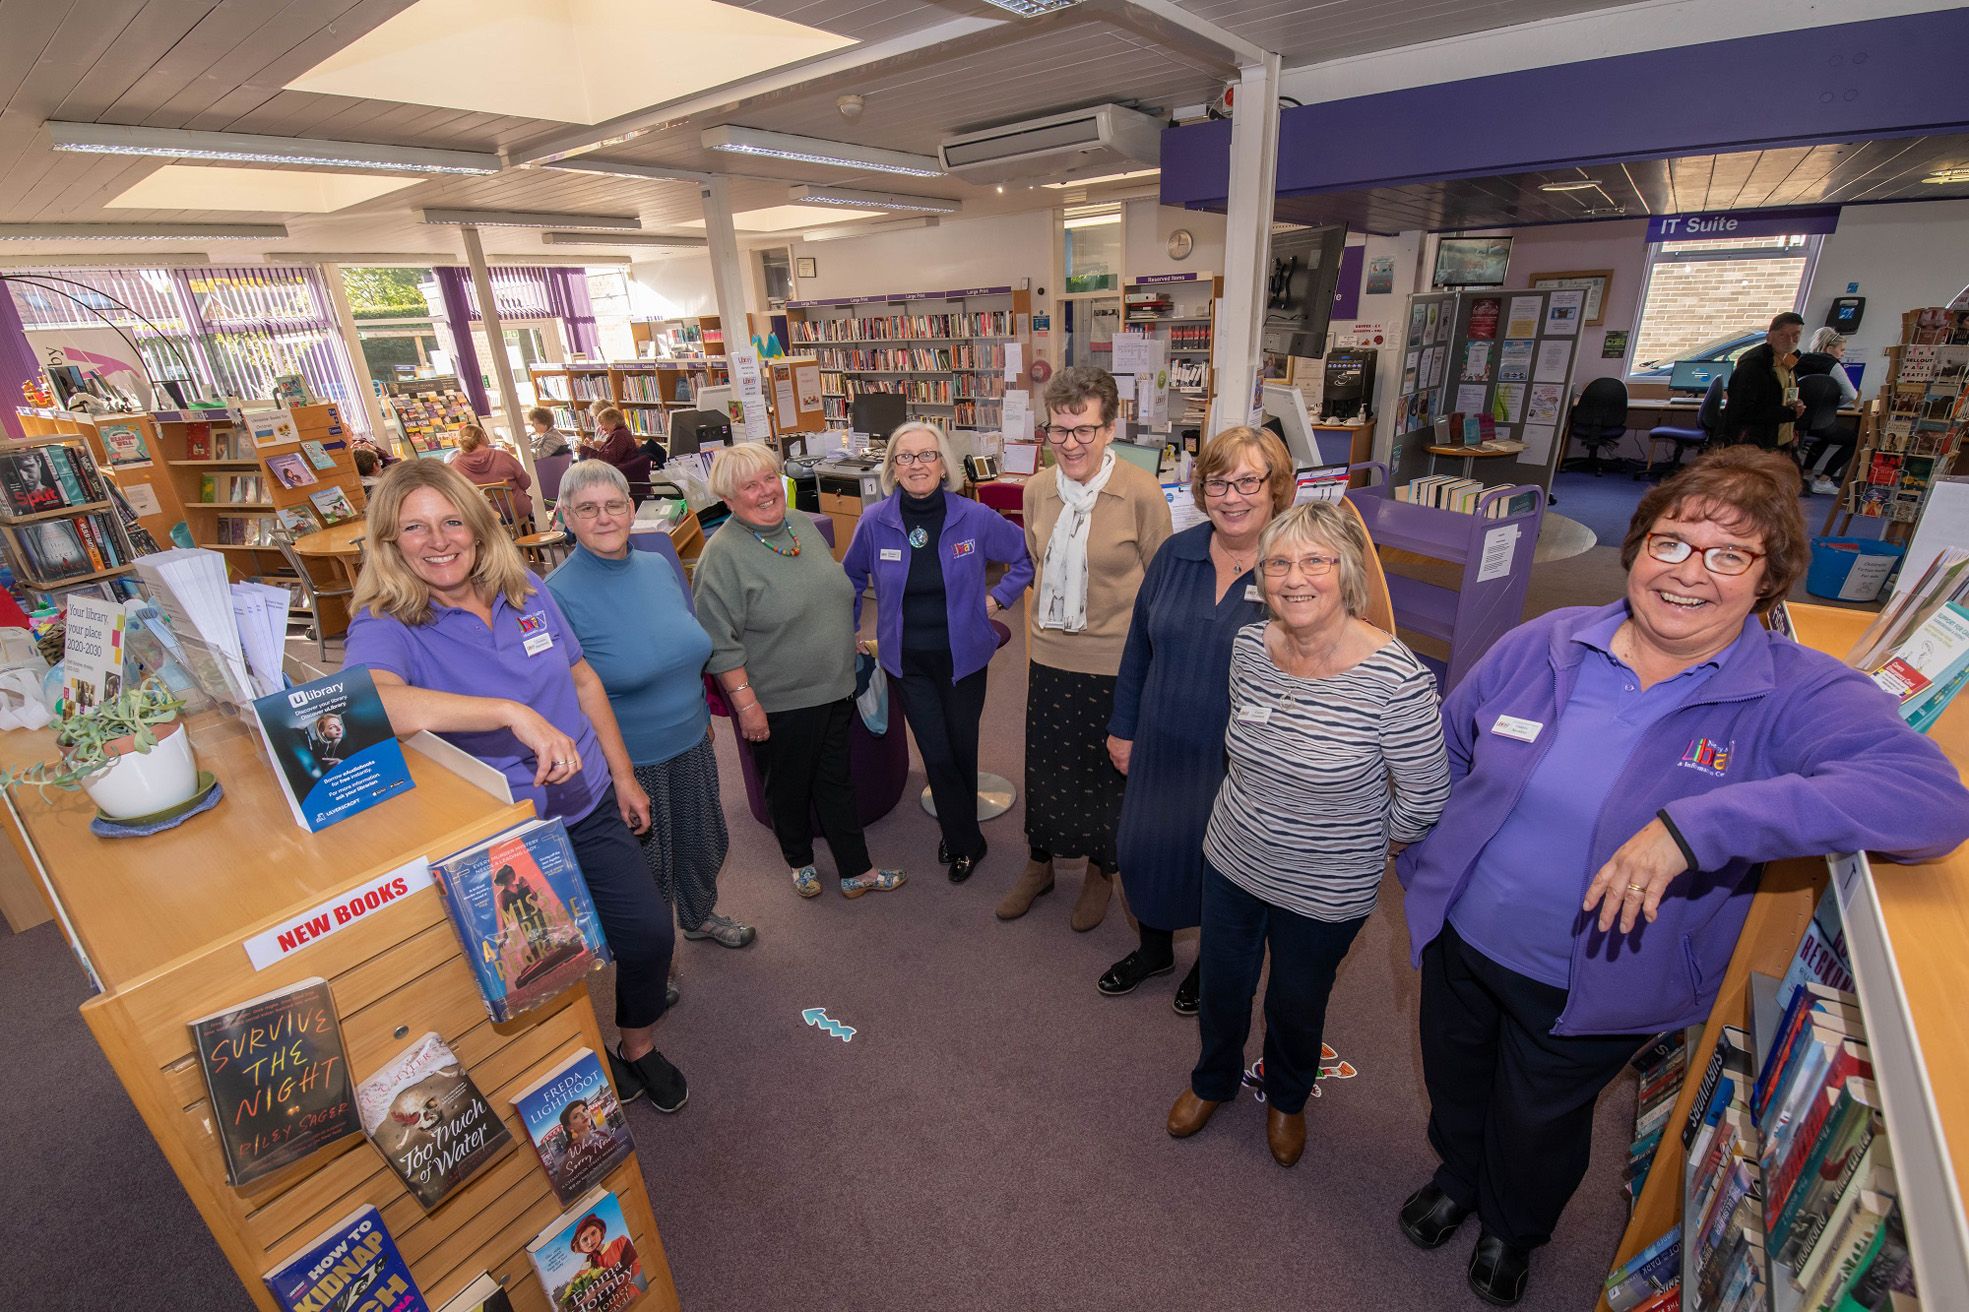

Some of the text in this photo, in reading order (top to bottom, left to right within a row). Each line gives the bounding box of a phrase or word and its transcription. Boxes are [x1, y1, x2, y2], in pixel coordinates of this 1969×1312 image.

[1660, 216, 1738, 235] IT Suite
[869, 484, 874, 492] 1
[69, 604, 84, 616] Your
[68, 623, 102, 640] your place
[67, 638, 102, 657] 2020-2030
[295, 704, 318, 716] Discover
[301, 709, 324, 720] Discover
[324, 774, 342, 784] Borrow
[338, 785, 350, 794] more
[515, 838, 539, 853] MYSTERY
[277, 877, 409, 953] NEW BOOKS
[500, 888, 549, 930] MISS
[210, 1008, 334, 1074] SURVIVE
[242, 1039, 308, 1087] THE
[395, 1052, 431, 1082] TYLER
[235, 1056, 340, 1126] NIGHT
[530, 1070, 599, 1124] LIGHTFOOT
[543, 1072, 582, 1102] FREDA
[1689, 1048, 1722, 1127] SURVIVORS
[239, 1123, 294, 1157] RILEY
[297, 1102, 350, 1133] SAGER
[400, 1142, 433, 1178] Too
[431, 1098, 488, 1150] Much
[419, 1160, 434, 1184] of
[433, 1123, 488, 1177] Water
[565, 1155, 592, 1177] Sorry
[308, 1220, 372, 1280] HOW TO
[293, 1231, 383, 1312] KIDNAP
[1642, 1258, 1661, 1275] DARK
[571, 1261, 623, 1306] Emma
